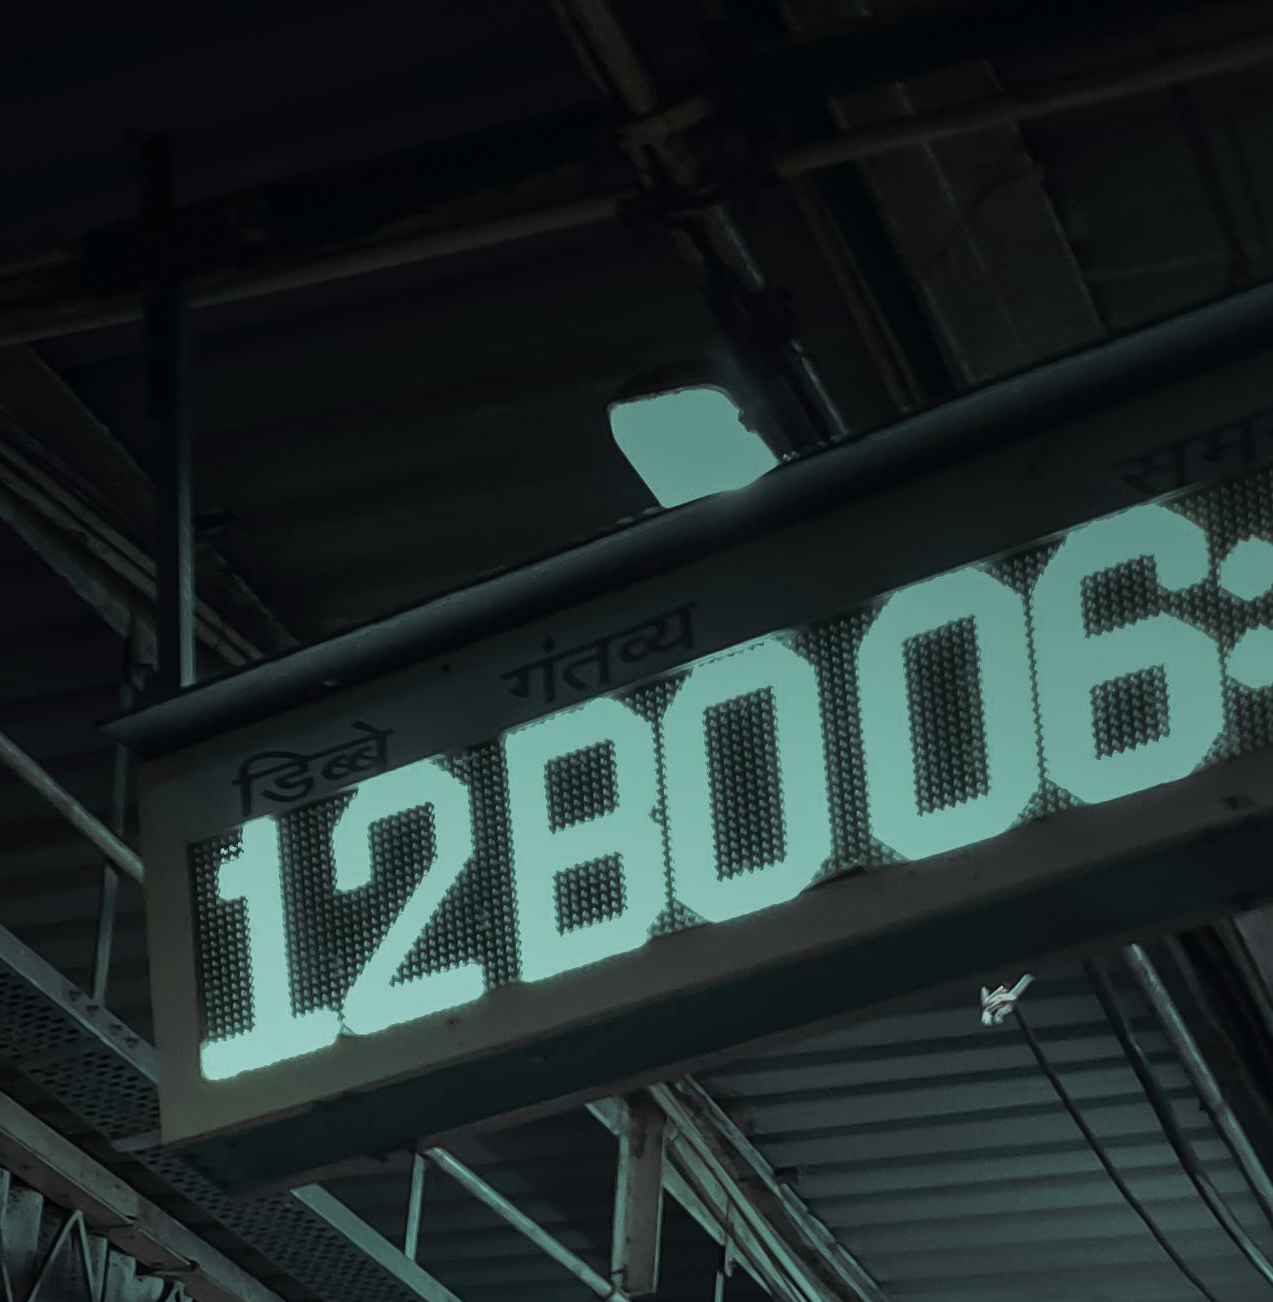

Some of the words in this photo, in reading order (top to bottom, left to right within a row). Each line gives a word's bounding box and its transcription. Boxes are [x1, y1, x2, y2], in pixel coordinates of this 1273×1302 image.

[231, 720, 392, 816] डिब्बे
[501, 602, 696, 703] गंतव्य
[1111, 408, 1273, 496] सम
[200, 754, 486, 1082] 12
